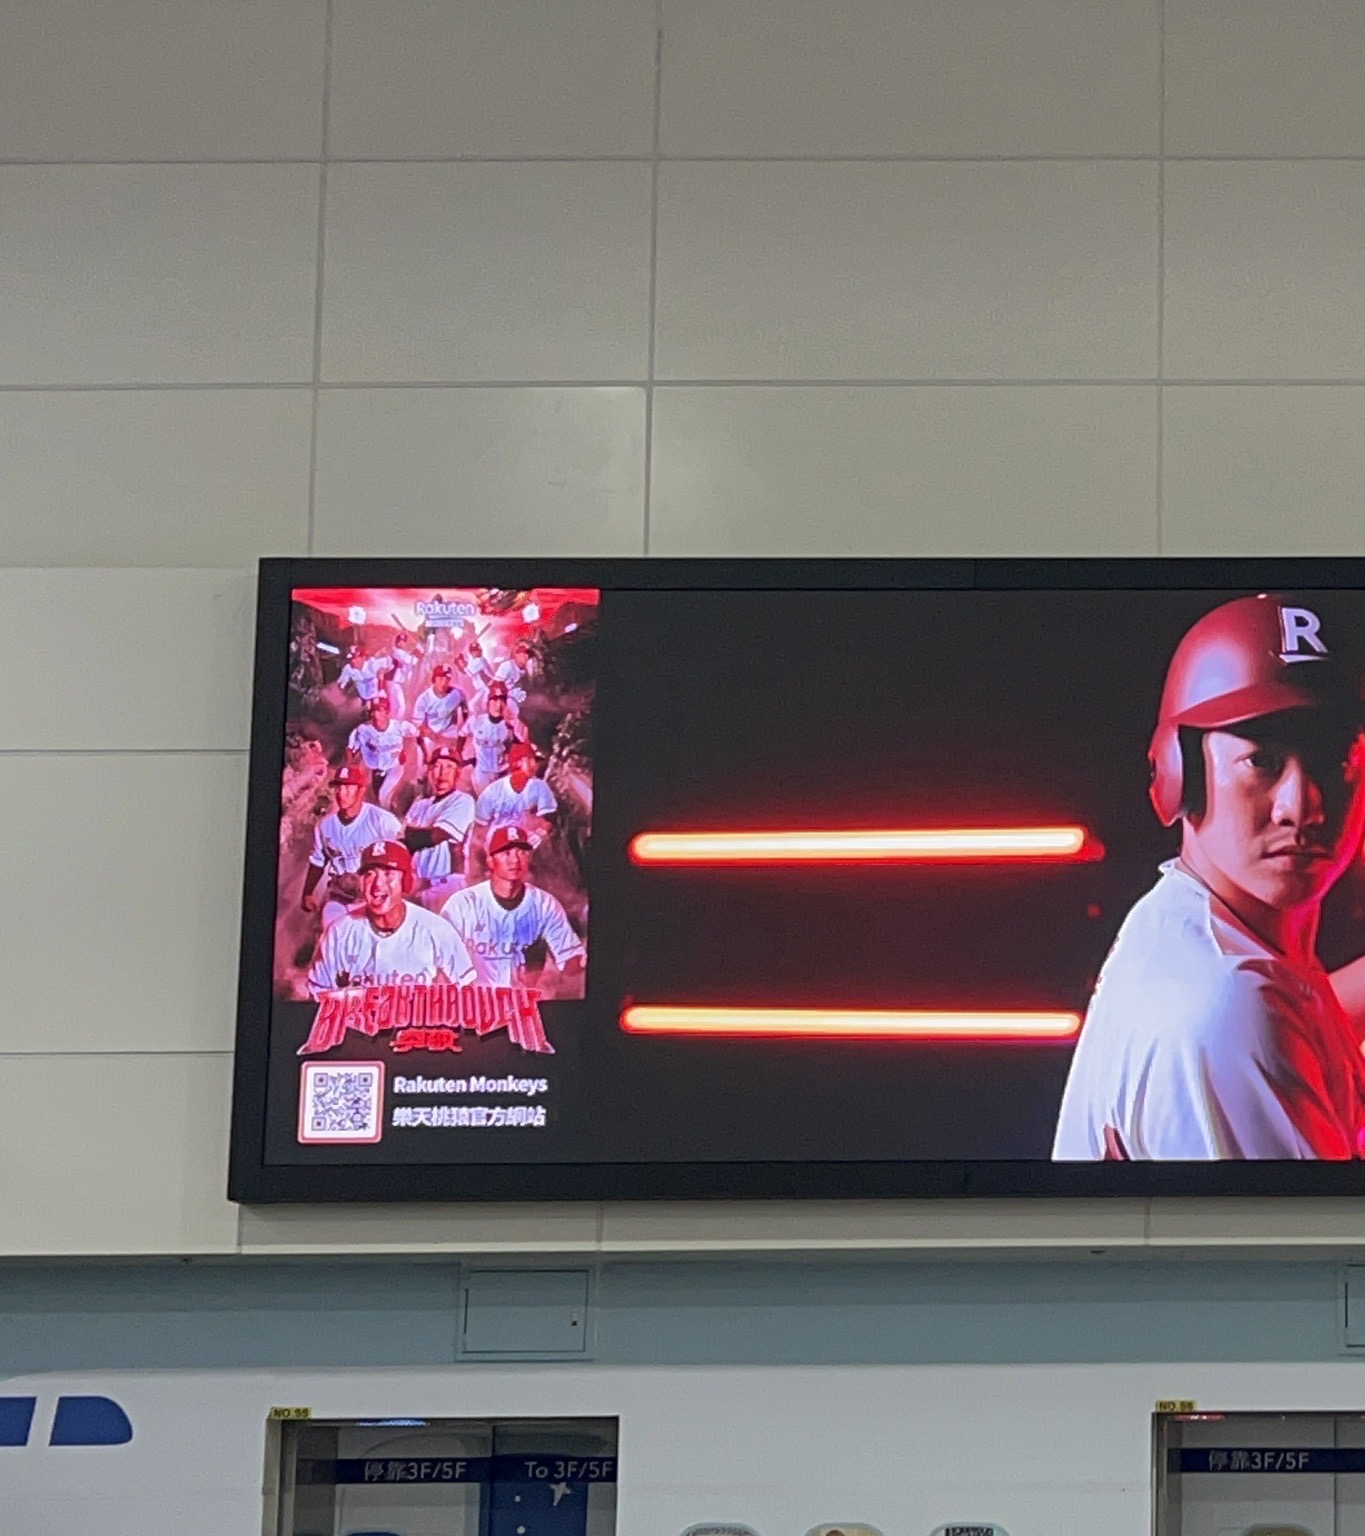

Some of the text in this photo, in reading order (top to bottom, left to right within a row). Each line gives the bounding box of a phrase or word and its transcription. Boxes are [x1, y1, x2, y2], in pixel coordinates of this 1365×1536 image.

[415, 600, 476, 616] Rakuten
[1278, 606, 1329, 653] R
[393, 1075, 548, 1096] Rakuten Monkeys
[392, 1106, 547, 1126] 樂天桃猿官方網站
[525, 1461, 614, 1479] To 3F/5F
